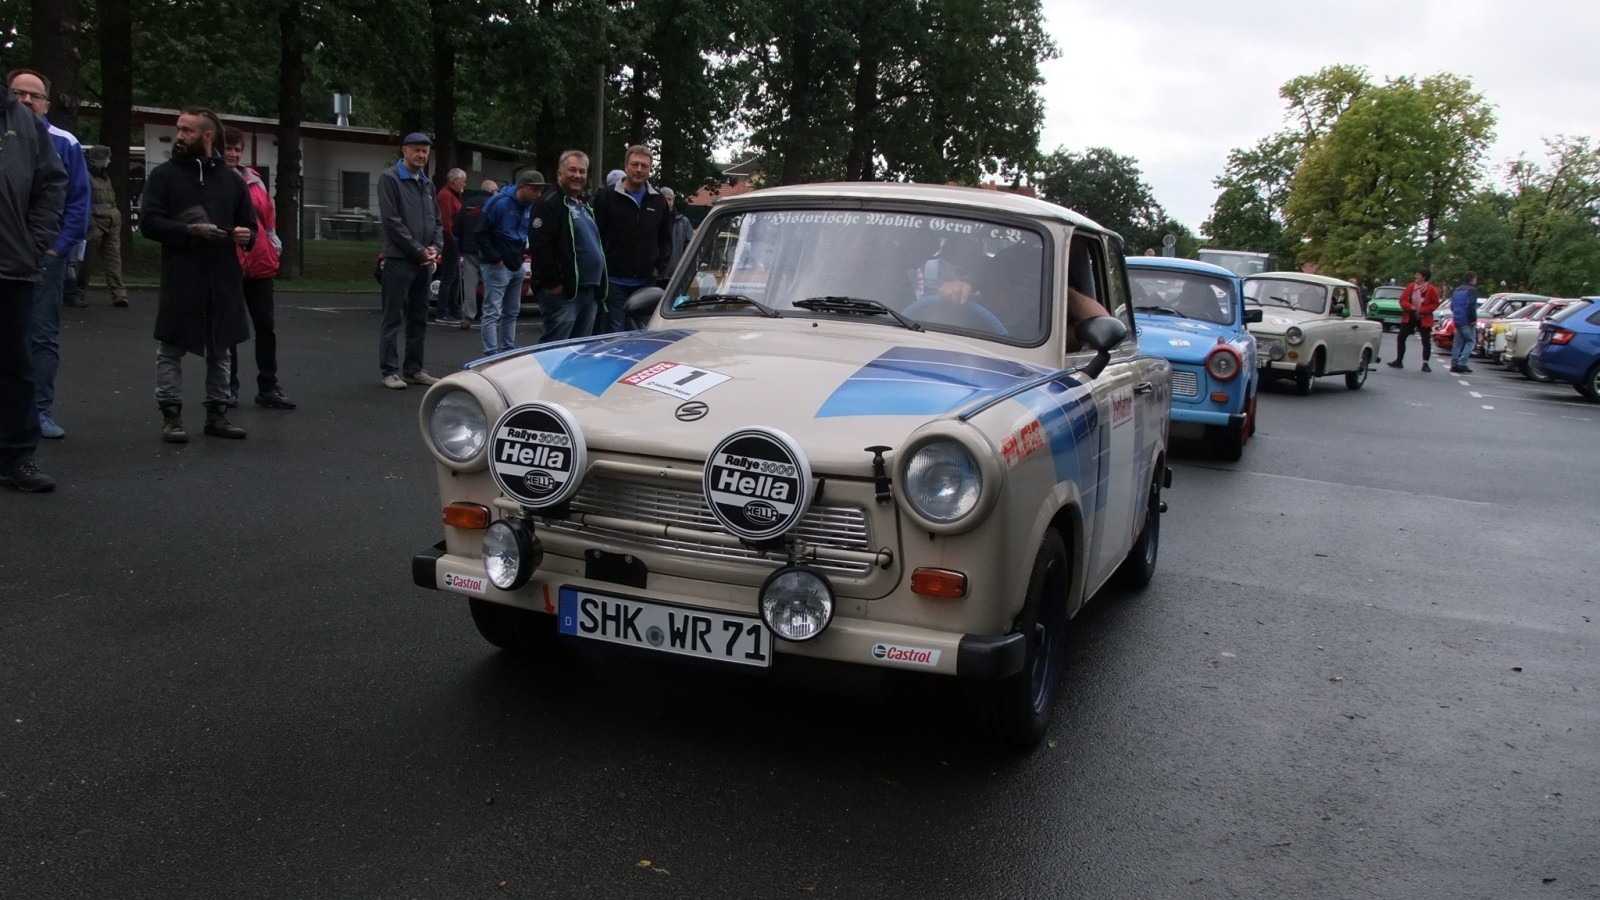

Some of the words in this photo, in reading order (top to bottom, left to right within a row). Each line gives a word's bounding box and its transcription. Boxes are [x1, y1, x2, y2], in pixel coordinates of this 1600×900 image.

[865, 213, 923, 229] Mobile
[673, 370, 708, 386] 1
[507, 428, 538, 442] Rallye
[538, 432, 569, 446] 3000
[501, 441, 565, 469] Hella
[724, 454, 760, 470] Rallye
[760, 461, 795, 477] 3000
[524, 475, 556, 490] HELLA
[717, 469, 790, 500] Hella
[745, 506, 779, 521] HELLA
[453, 575, 482, 591] Castrol
[579, 597, 643, 643] SHK
[668, 612, 712, 654] WR
[722, 619, 766, 662] 71
[887, 646, 932, 663] Castrol
